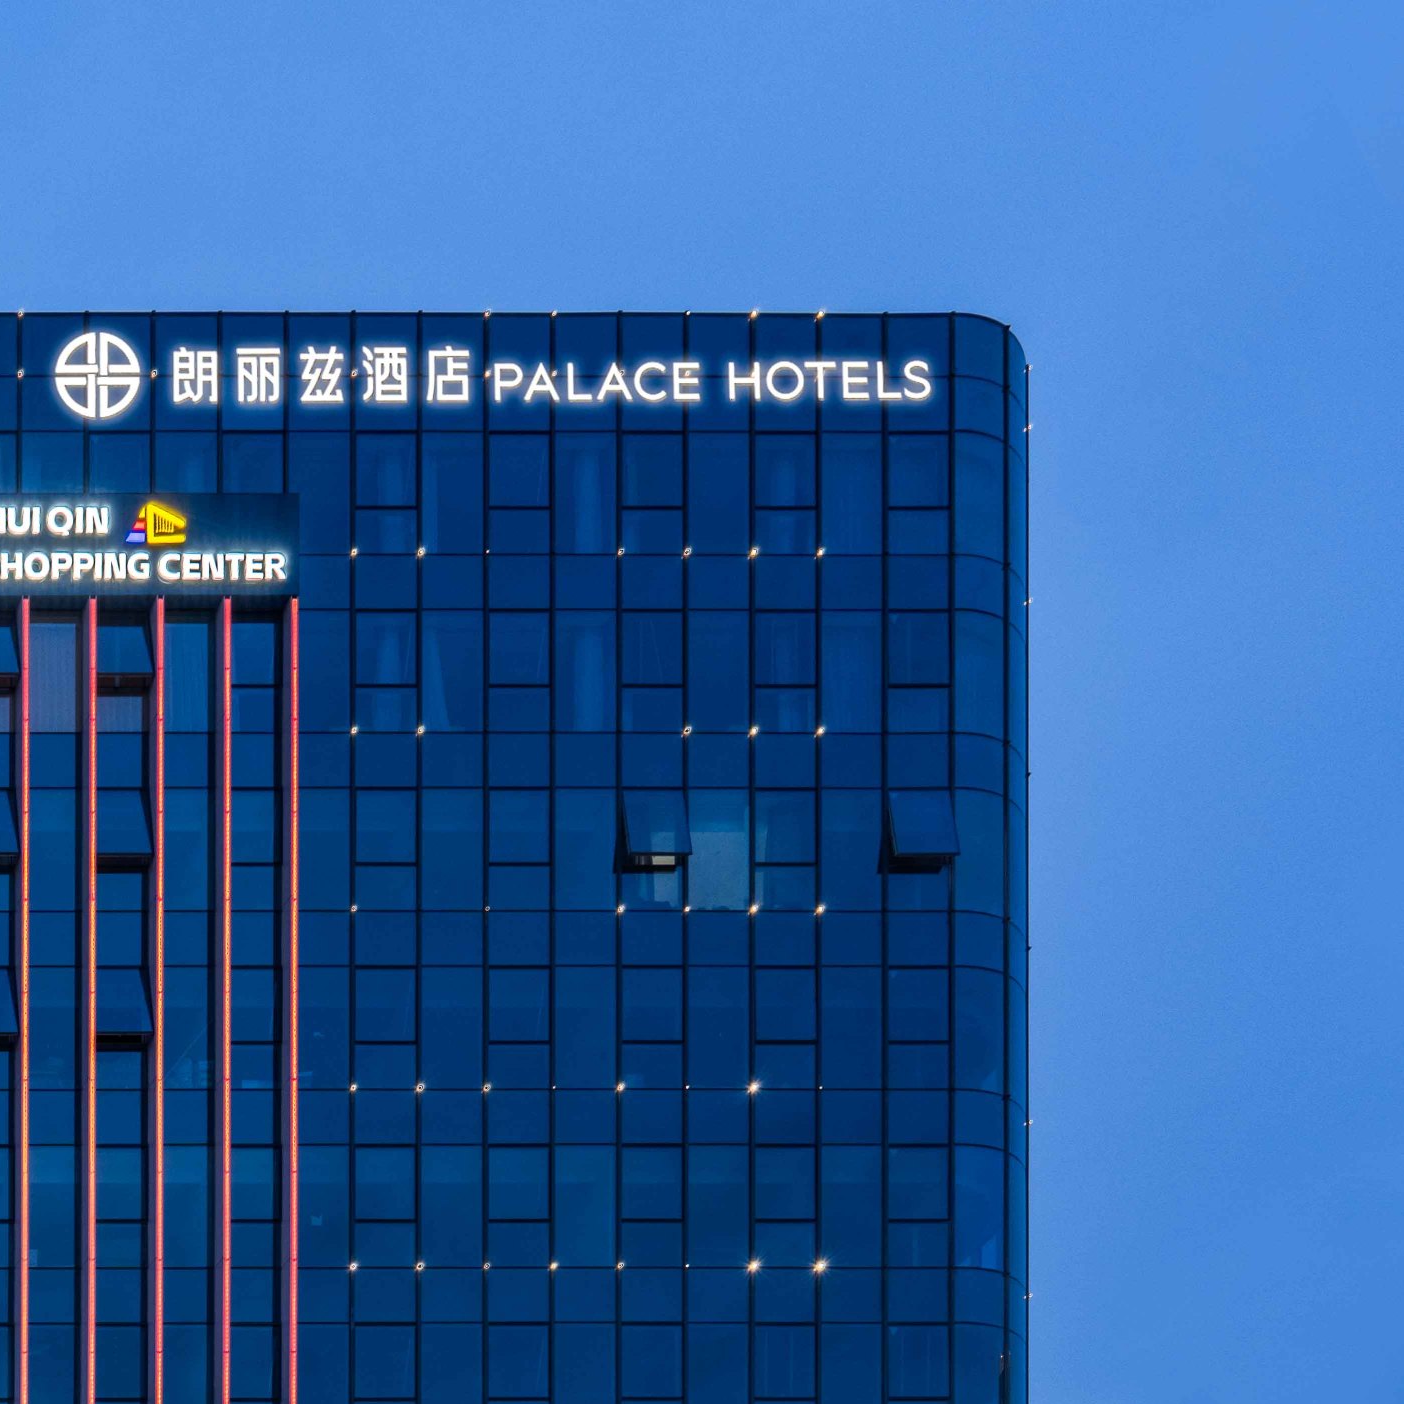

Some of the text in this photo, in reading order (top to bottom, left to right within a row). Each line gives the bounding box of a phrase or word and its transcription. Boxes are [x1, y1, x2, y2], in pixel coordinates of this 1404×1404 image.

[171, 346, 470, 404] 朗丽兹酒店
[493, 360, 932, 401] PALACE HOTELS
[53, 506, 109, 538] QIN
[157, 552, 286, 582] CENTER
